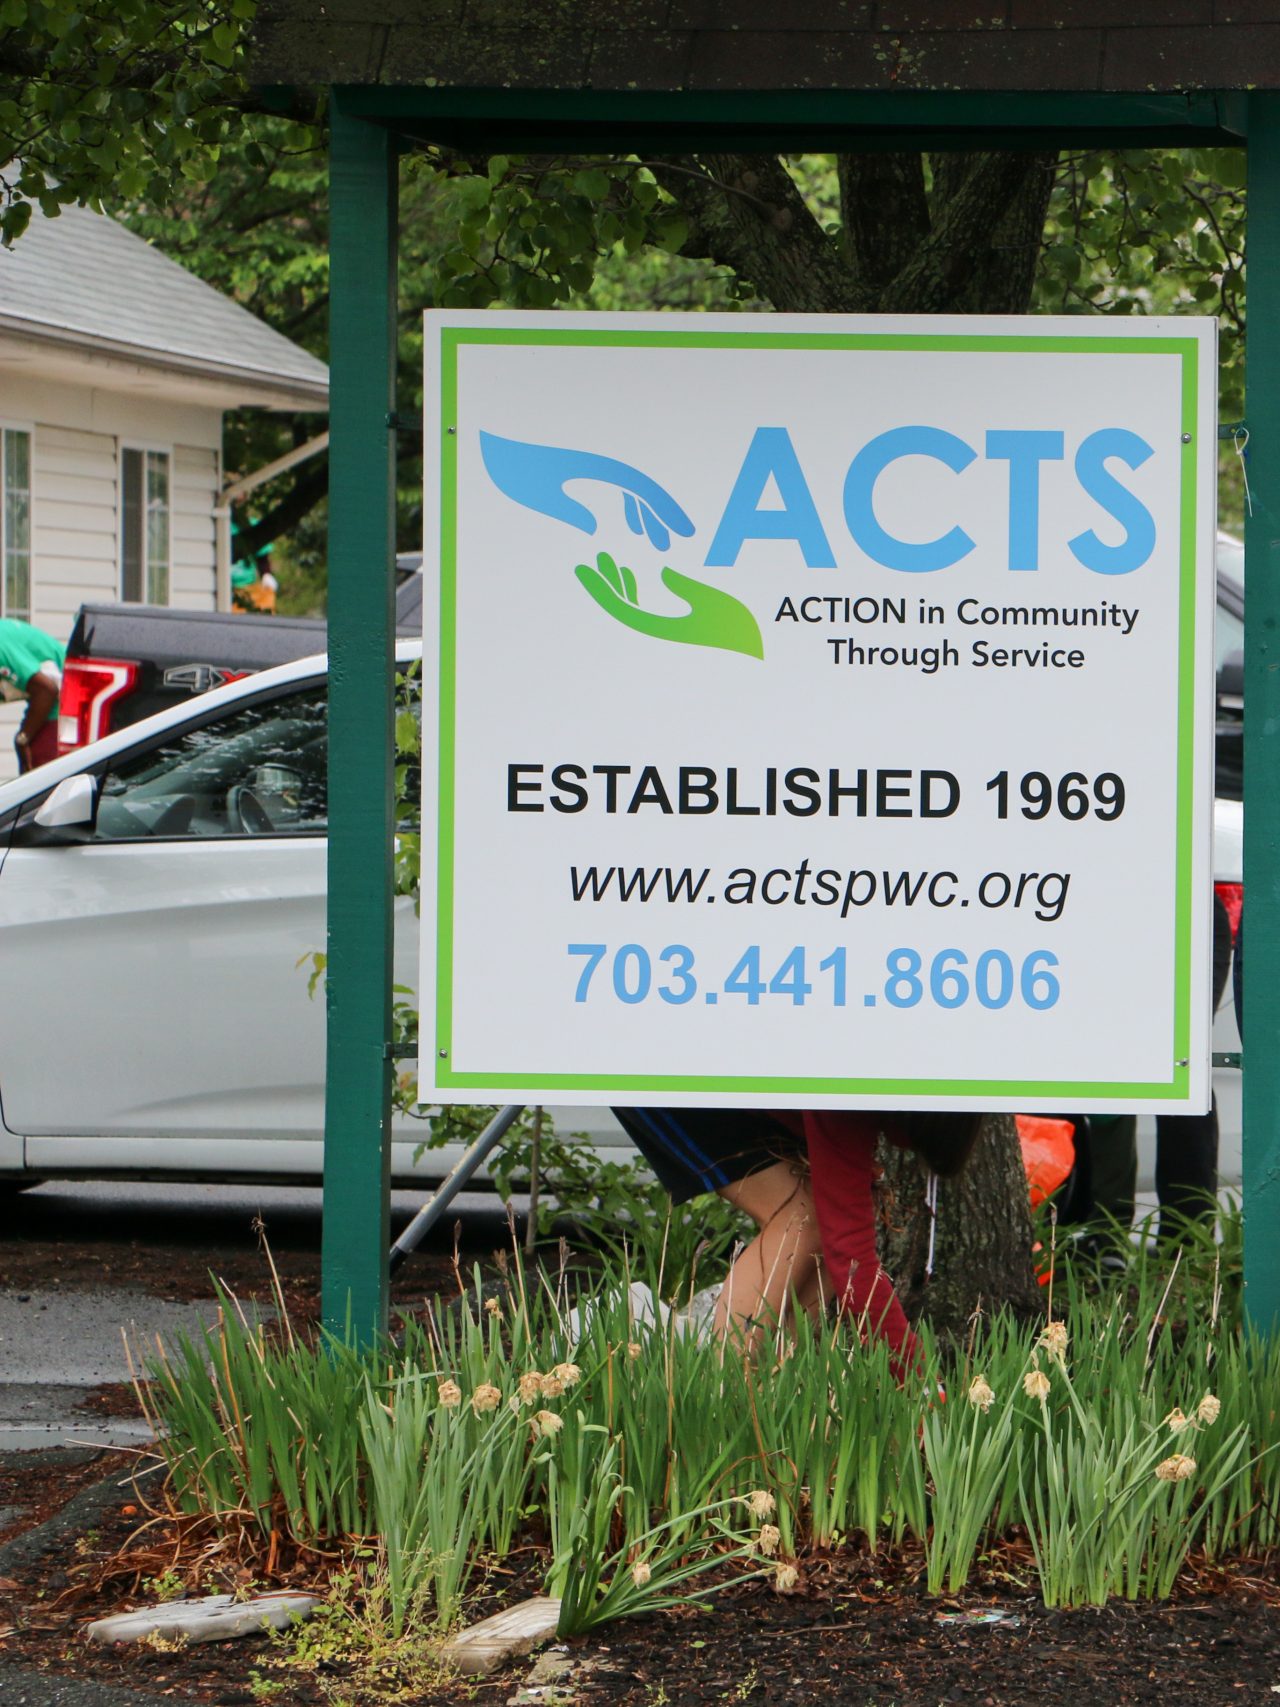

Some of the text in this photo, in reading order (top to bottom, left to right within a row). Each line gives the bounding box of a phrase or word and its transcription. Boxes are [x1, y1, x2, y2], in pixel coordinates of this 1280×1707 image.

[703, 425, 1157, 575] ACTS
[774, 597, 1140, 634] ACTION in Community
[827, 638, 1085, 673] Through Service
[507, 763, 1127, 822] ESTABLISHED 1969
[570, 858, 1072, 922] www.actspwc.org
[566, 943, 1062, 1011] 703.441.8606
